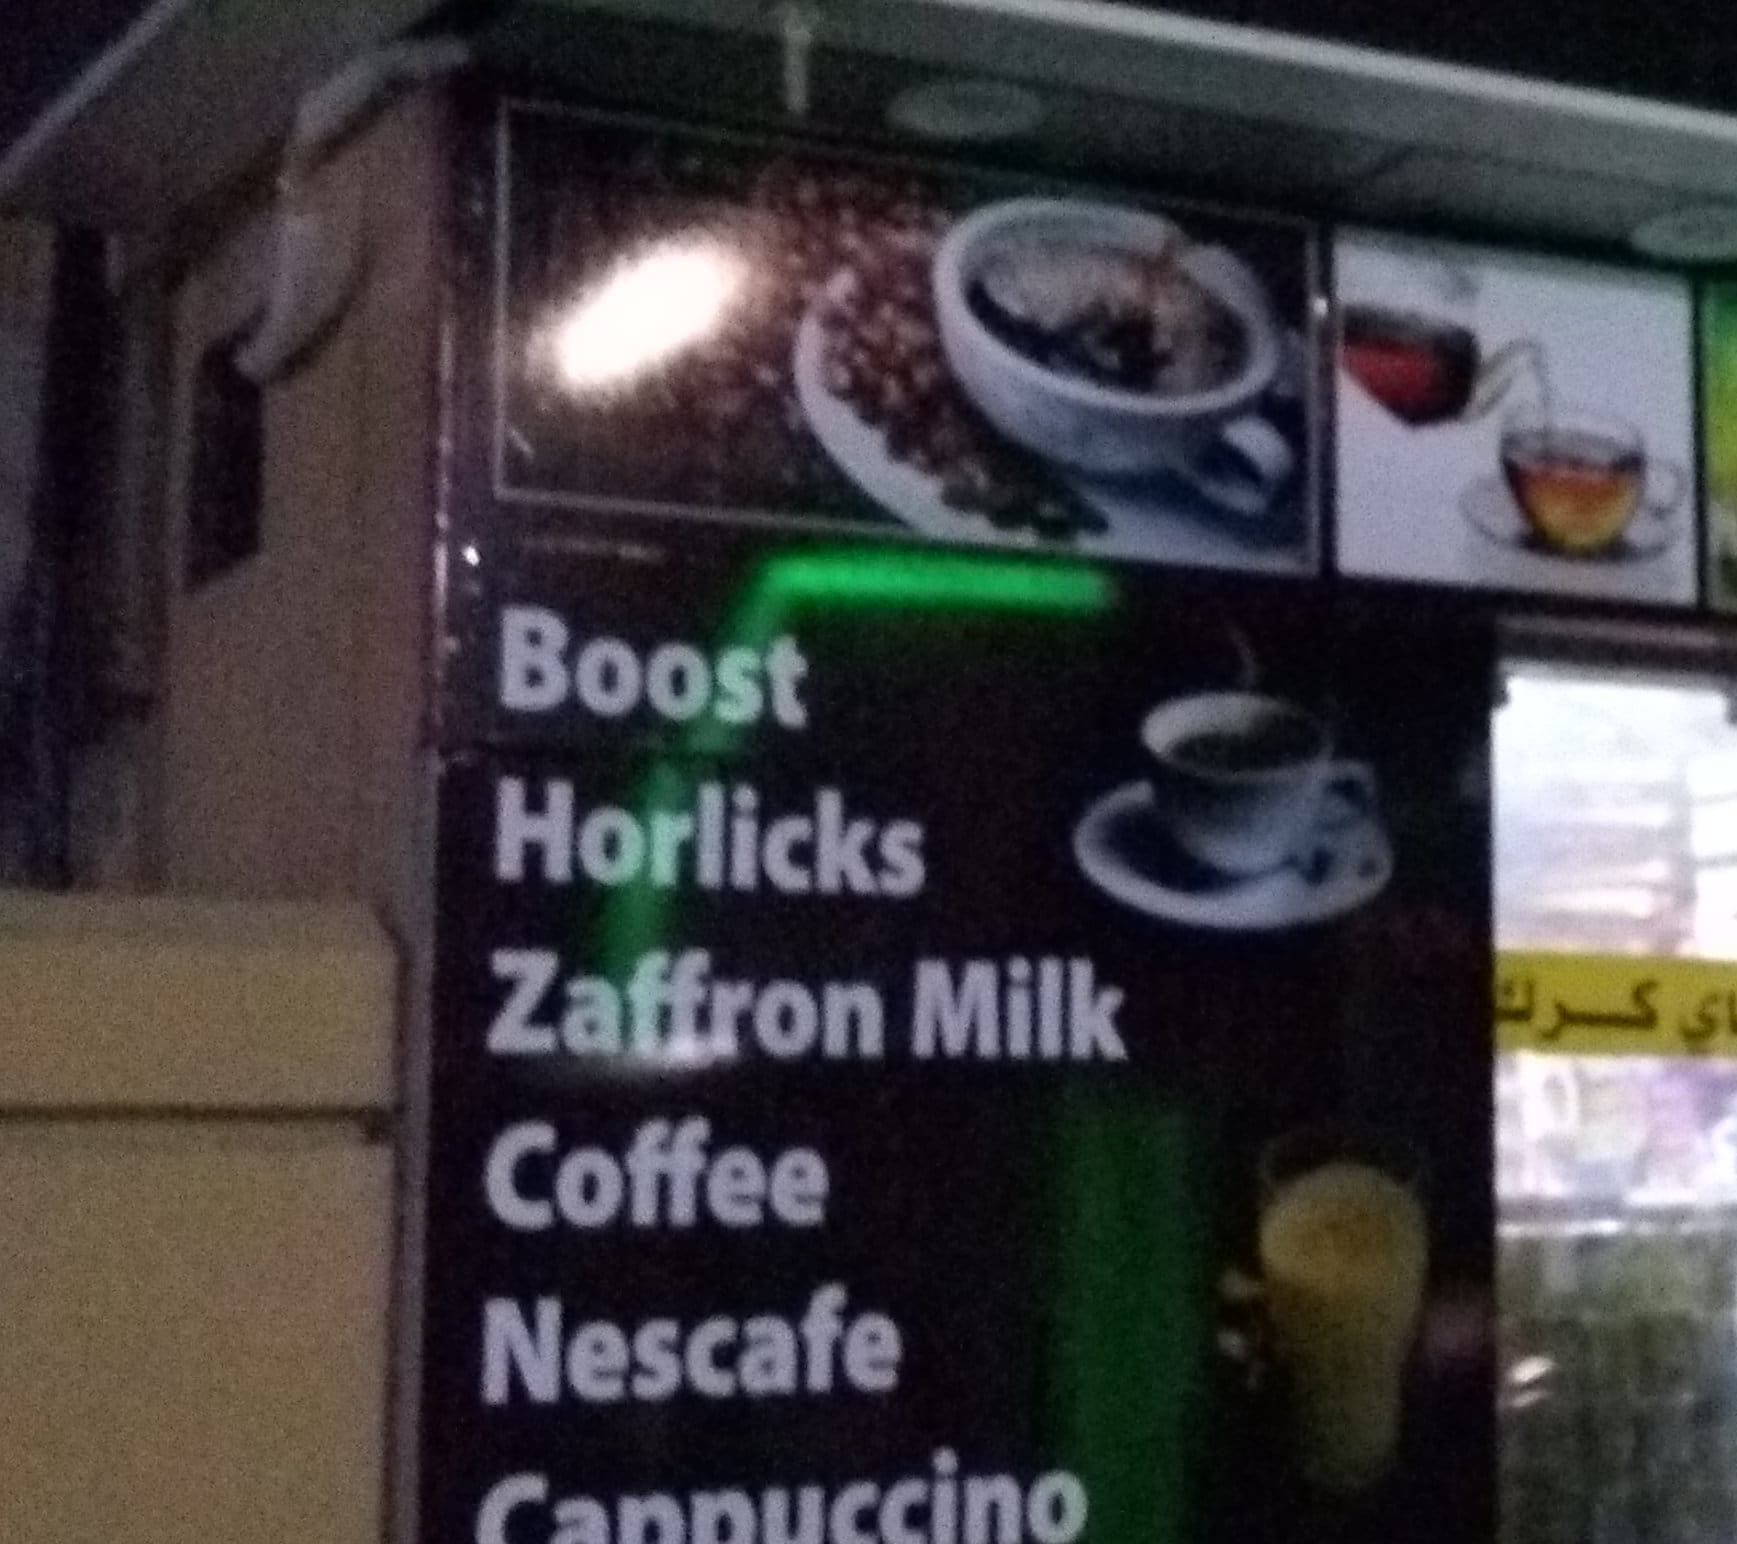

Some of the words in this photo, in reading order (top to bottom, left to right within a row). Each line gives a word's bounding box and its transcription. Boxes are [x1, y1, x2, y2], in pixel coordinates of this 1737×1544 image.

[499, 604, 810, 731] Boost
[492, 773, 927, 899] Horlicks
[485, 946, 886, 1061] Zaffron
[909, 955, 1130, 1063] Milk
[482, 1114, 831, 1232] Coffee
[479, 1280, 904, 1406] Nescafe
